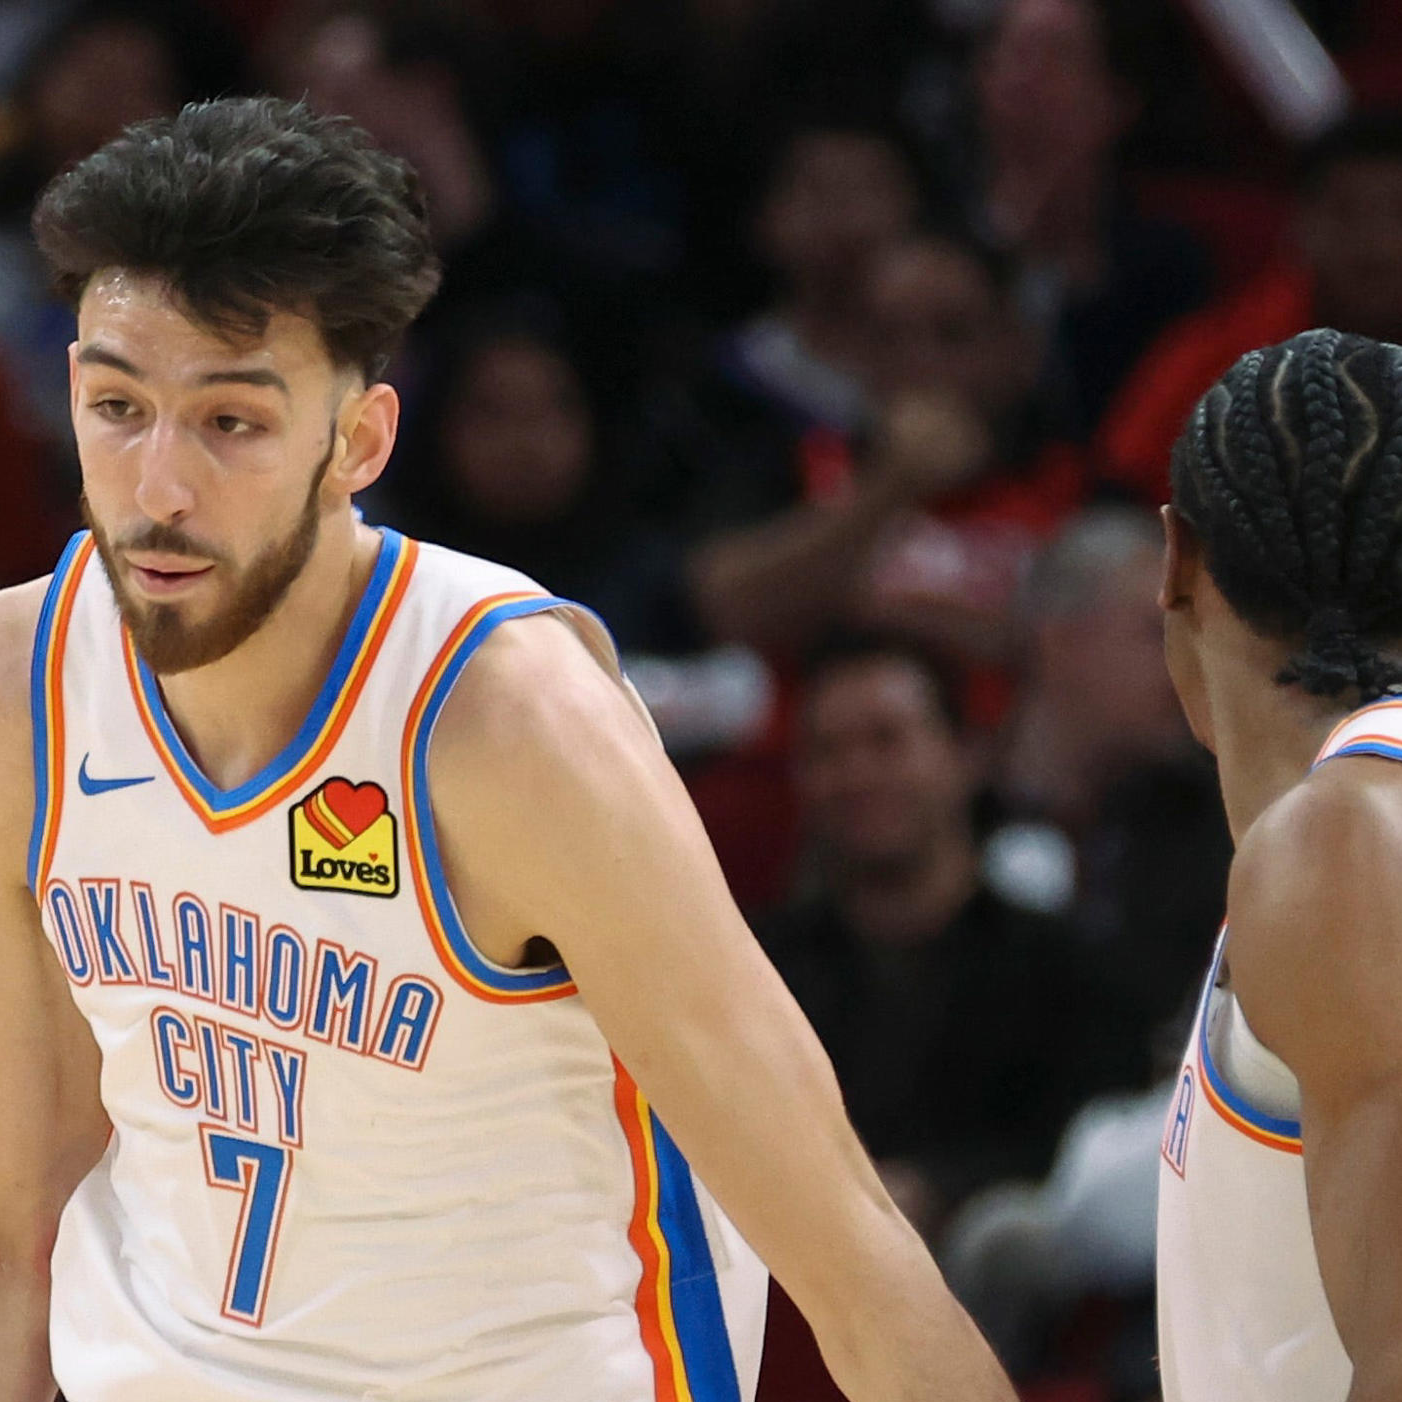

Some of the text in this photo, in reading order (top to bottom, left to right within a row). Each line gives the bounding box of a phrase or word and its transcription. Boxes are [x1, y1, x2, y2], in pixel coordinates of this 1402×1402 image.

[47, 878, 444, 1072] OKLAHOMA
[152, 1006, 307, 1149] CITY
[198, 1123, 293, 1328] 7
